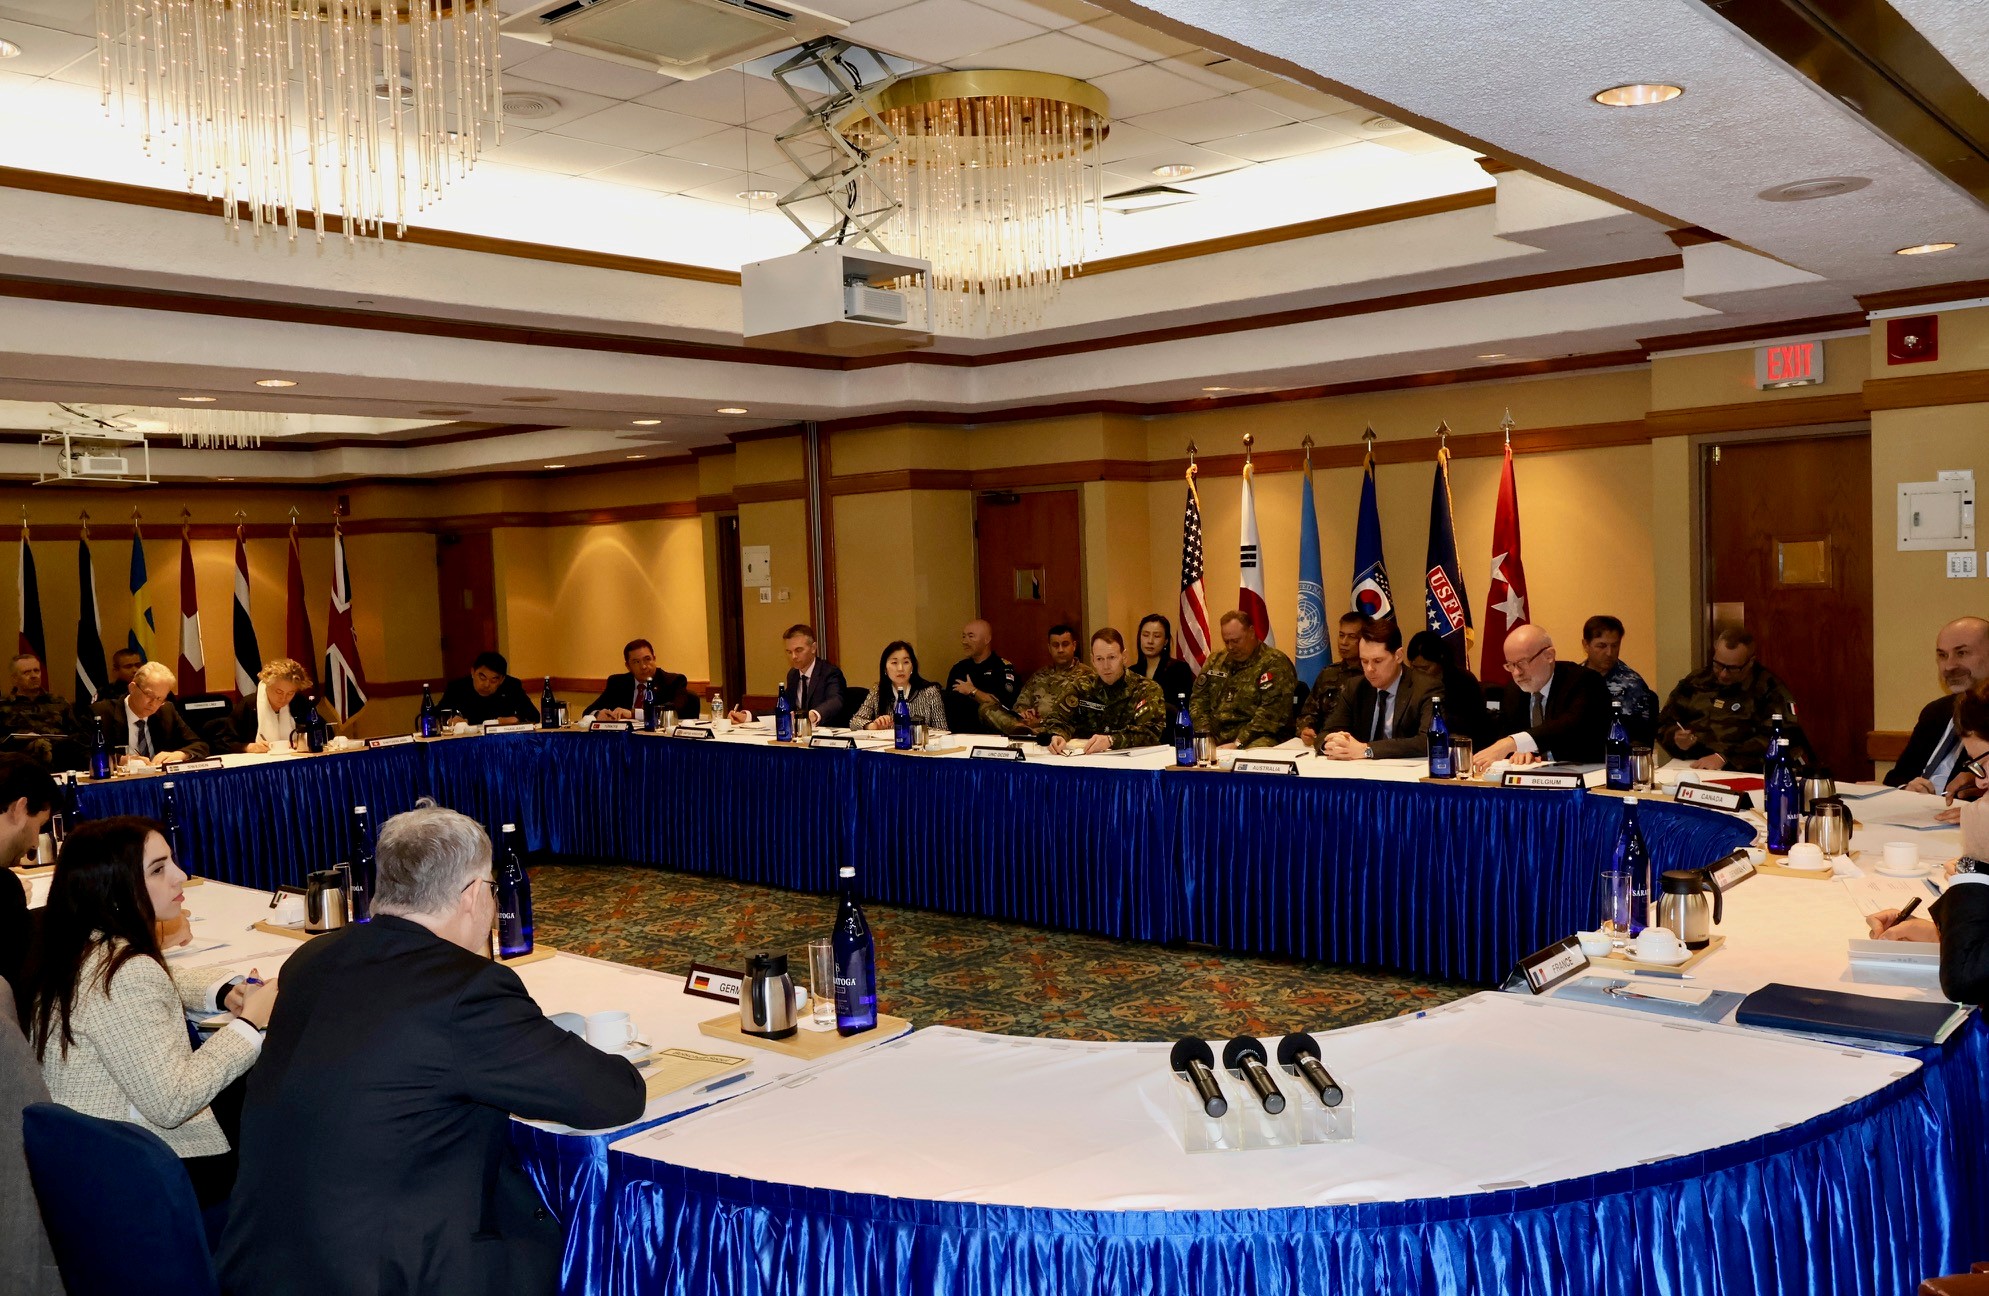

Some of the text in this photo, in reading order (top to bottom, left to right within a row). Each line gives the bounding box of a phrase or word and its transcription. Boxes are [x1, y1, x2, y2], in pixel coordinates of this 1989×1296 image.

[1767, 343, 1814, 380] EXIT
[1430, 571, 1464, 627] USFK
[1701, 793, 1723, 803] CANADA
[1551, 956, 1574, 973] FRANCE
